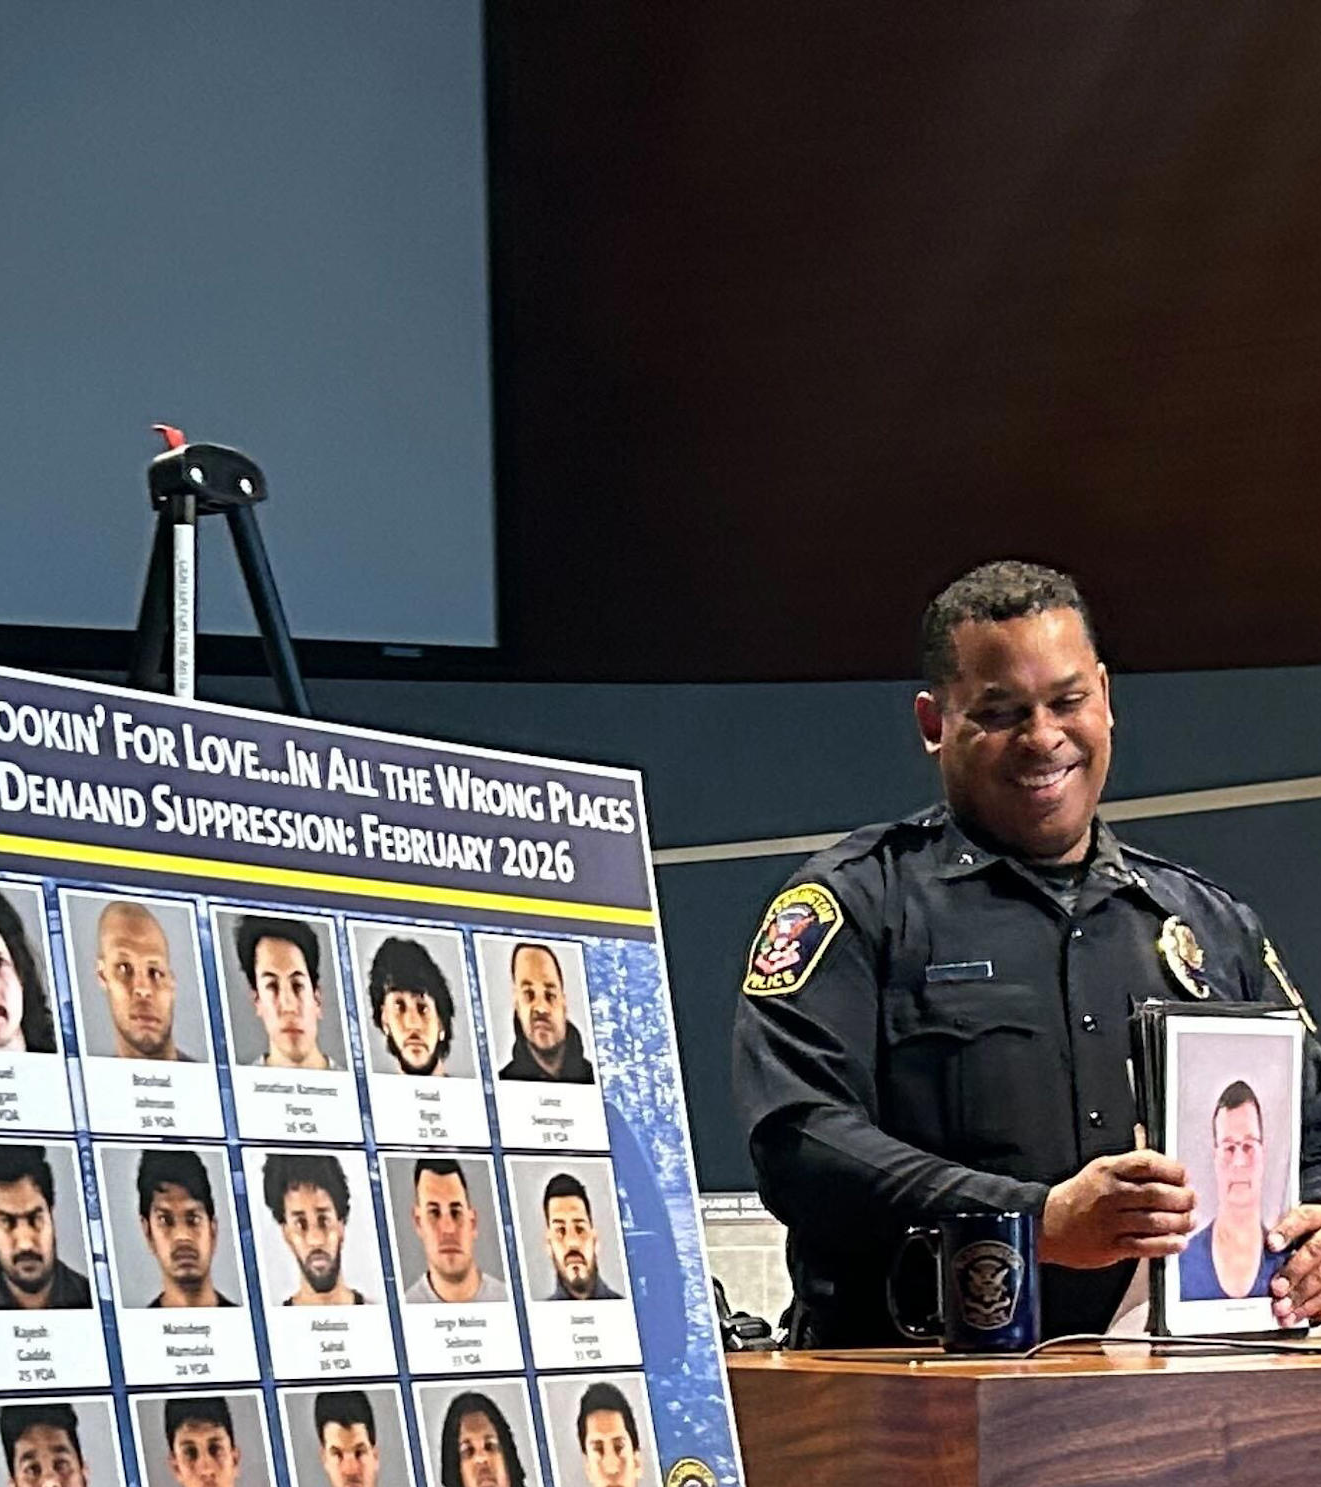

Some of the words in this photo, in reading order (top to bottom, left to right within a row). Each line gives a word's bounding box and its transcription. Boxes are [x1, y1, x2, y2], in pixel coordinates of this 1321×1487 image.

[112, 712, 179, 768] FOR
[328, 747, 378, 798] ALL
[379, 763, 436, 805] THE
[434, 764, 545, 822] WRONG
[548, 780, 636, 835] PLACES
[151, 783, 358, 858] SUPPRESSION:
[361, 814, 494, 874] FEBRUARY
[500, 837, 575, 883] 2026
